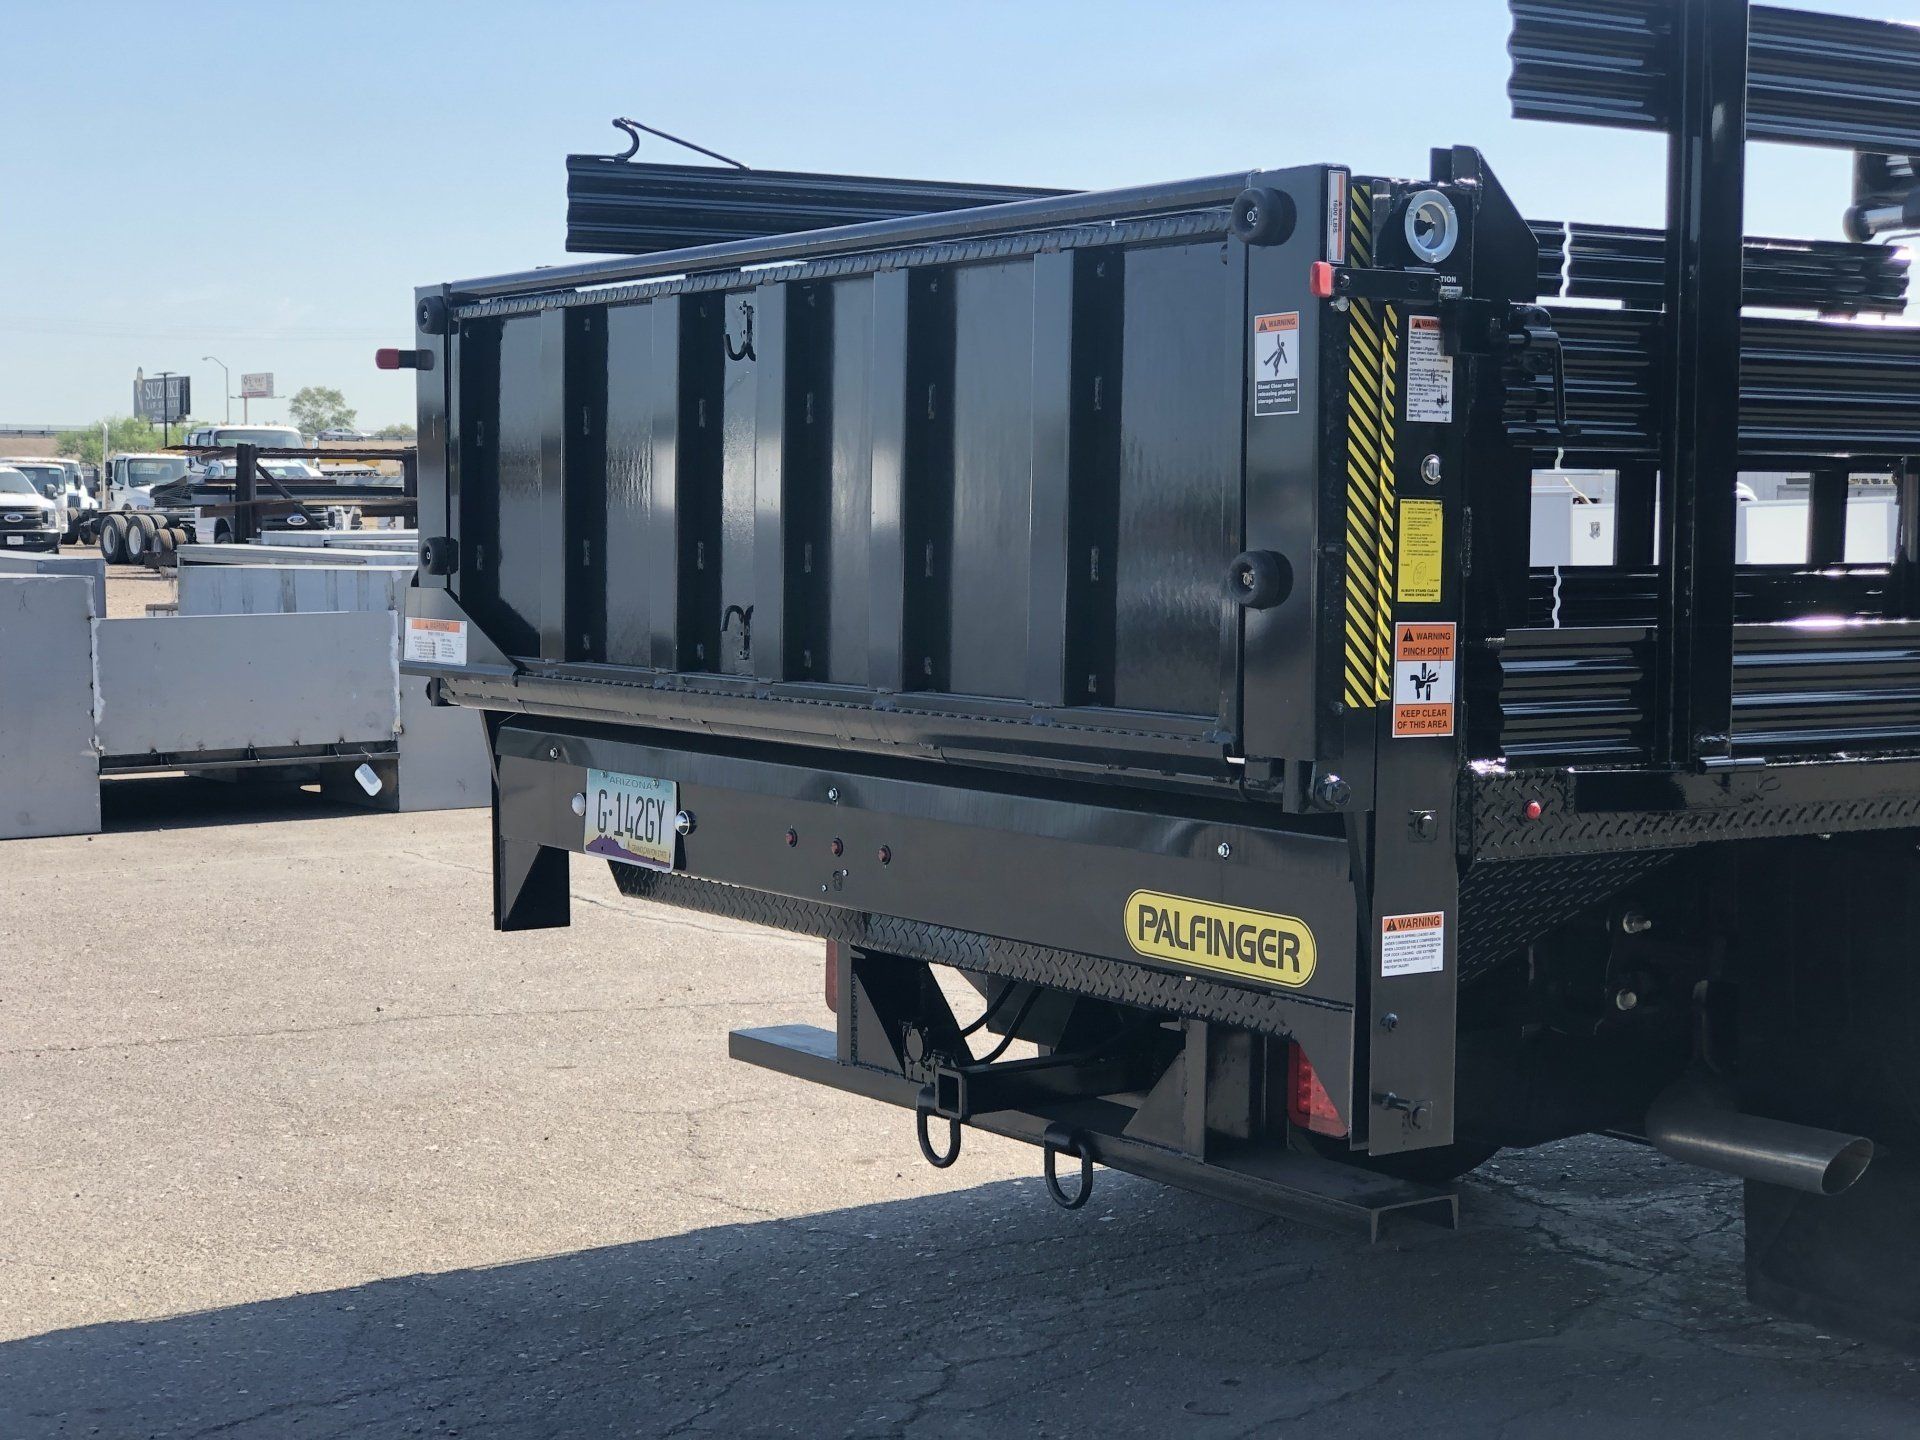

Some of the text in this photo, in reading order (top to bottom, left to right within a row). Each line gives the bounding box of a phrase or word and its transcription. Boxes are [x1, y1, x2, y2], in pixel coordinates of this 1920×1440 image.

[1268, 318, 1295, 327] WARNING
[1416, 632, 1450, 640] WARNING
[1428, 647, 1449, 655] POINT
[1422, 709, 1447, 717] CLEAR
[1397, 721, 1407, 729] OF
[610, 776, 653, 790] ARIZONA
[1398, 916, 1440, 928] WARNING
[1138, 904, 1300, 973] PALFINGER
